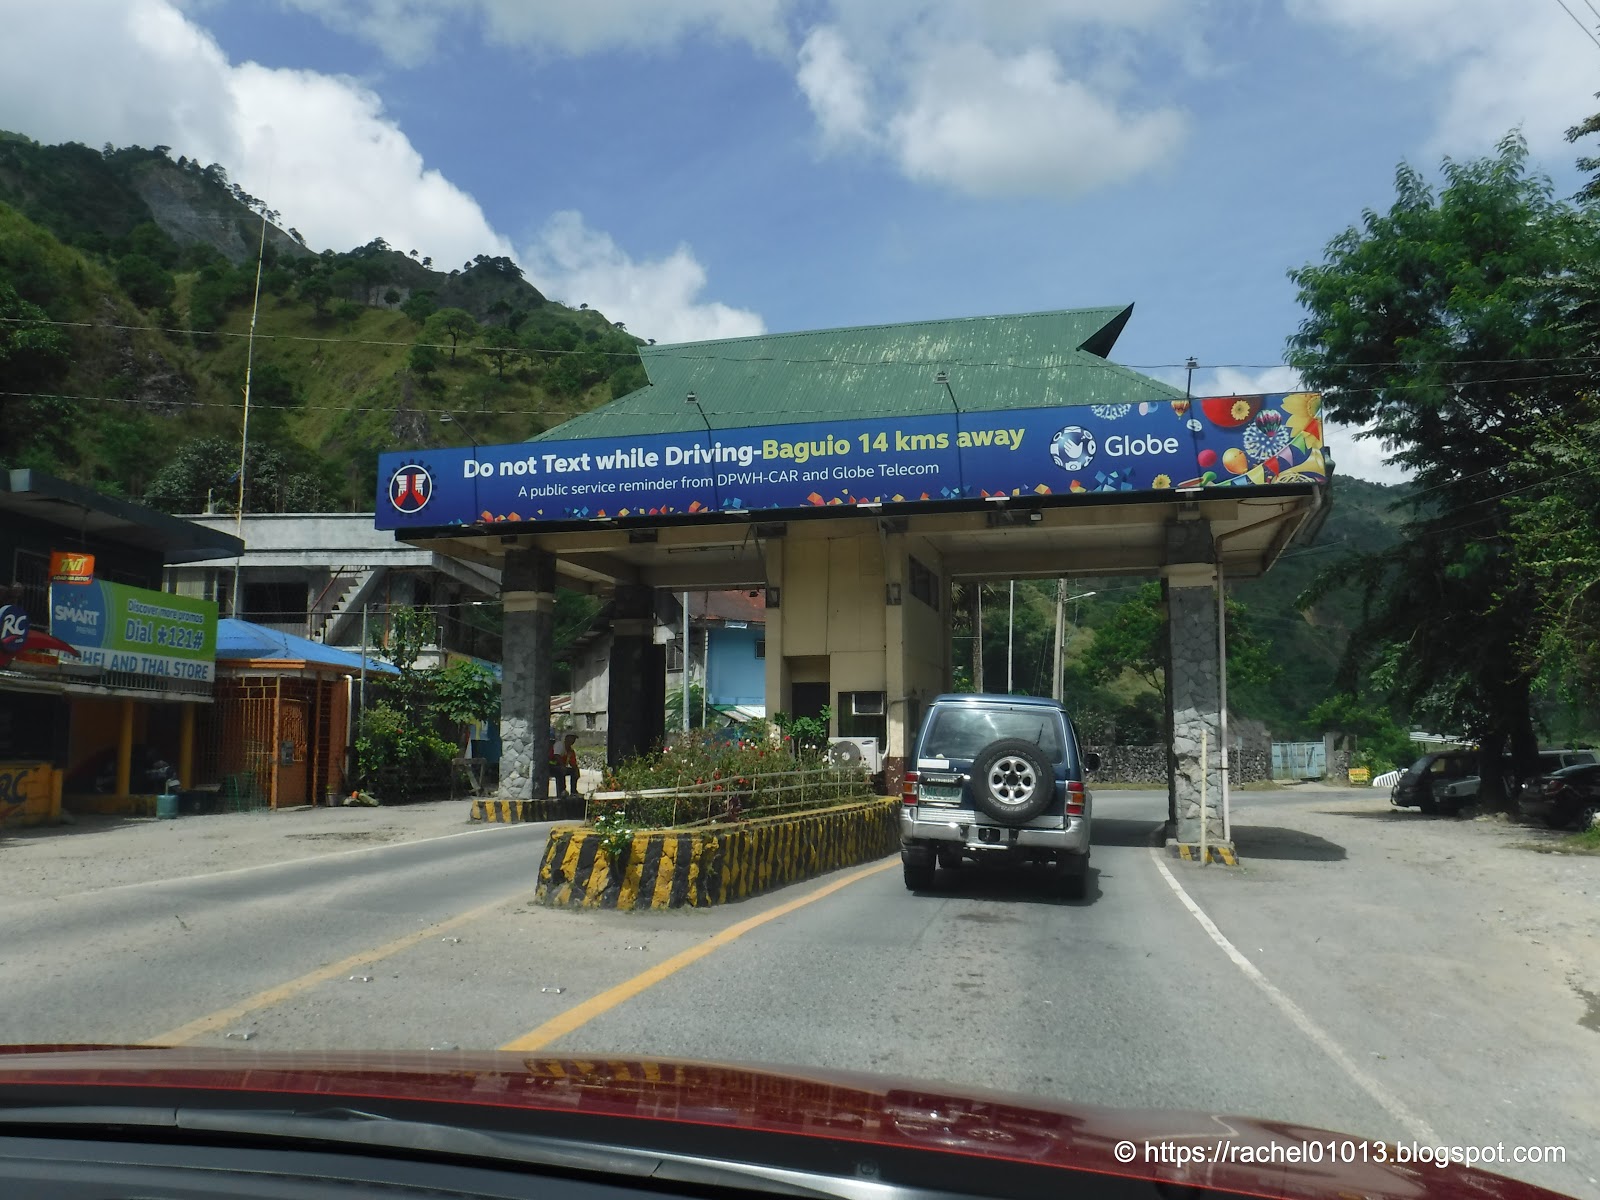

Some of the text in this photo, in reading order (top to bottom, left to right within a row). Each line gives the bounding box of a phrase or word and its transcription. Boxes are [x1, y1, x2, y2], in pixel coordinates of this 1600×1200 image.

[463, 459, 493, 478] Do
[499, 455, 537, 475] not
[542, 452, 591, 473] Text
[595, 447, 659, 470] while
[858, 432, 889, 453] 14
[895, 430, 949, 451] kms
[955, 428, 1025, 451] away
[1104, 433, 1179, 457] Globe
[518, 461, 940, 500] A public service reminder from DPWH-CAR and Globe Telecom
[55, 605, 100, 626] SMART
[127, 598, 204, 624] Discover more promos
[1, 613, 27, 639] RC
[125, 618, 153, 643] Dial
[111, 654, 137, 672] AND
[142, 658, 170, 675] THAL
[174, 661, 209, 679] STORE
